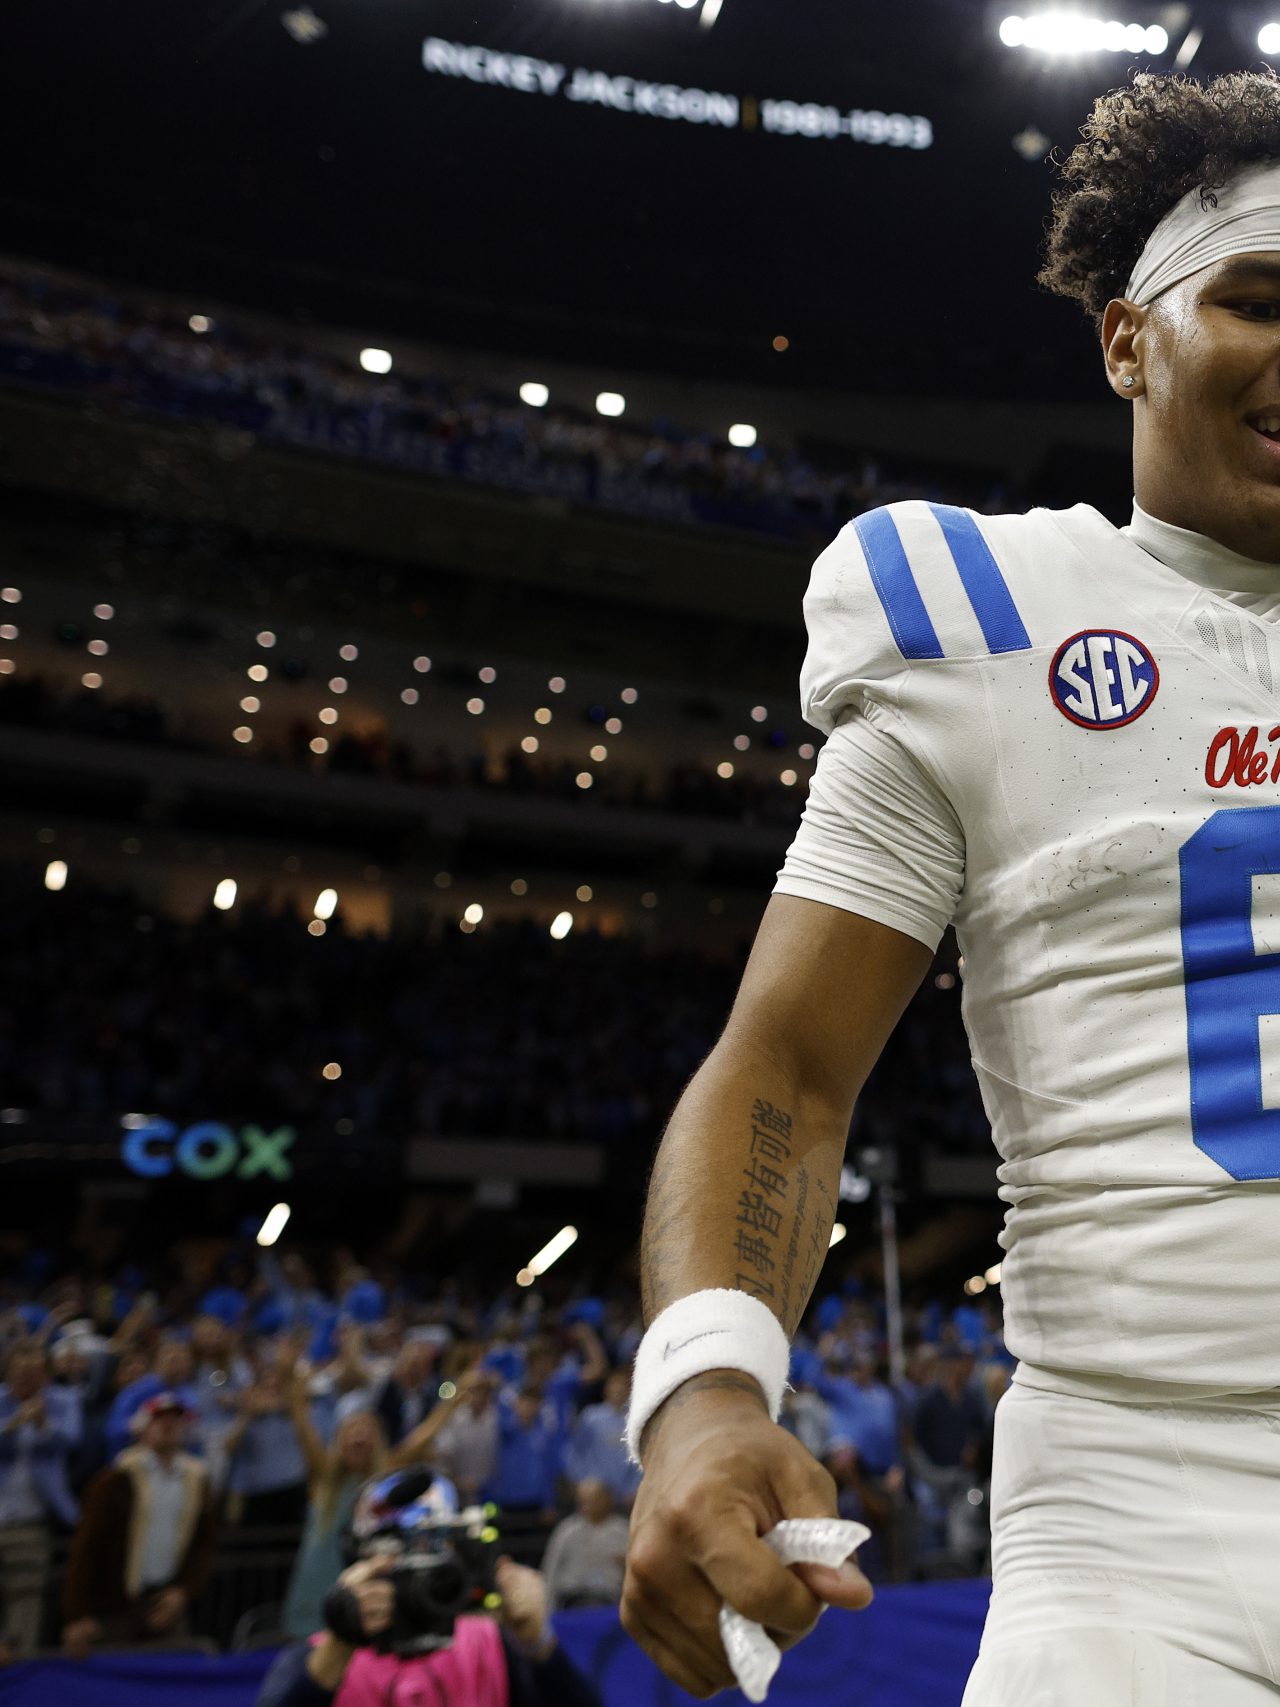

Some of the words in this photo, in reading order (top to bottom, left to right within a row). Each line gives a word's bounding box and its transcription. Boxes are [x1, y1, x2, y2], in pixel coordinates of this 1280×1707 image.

[422, 36, 566, 96] RICKEY
[566, 68, 740, 128] JACKSON
[762, 98, 933, 150] 1981-1993
[1057, 636, 1150, 722] SEC
[1205, 726, 1268, 789] Ole
[121, 1118, 295, 1182] COX
